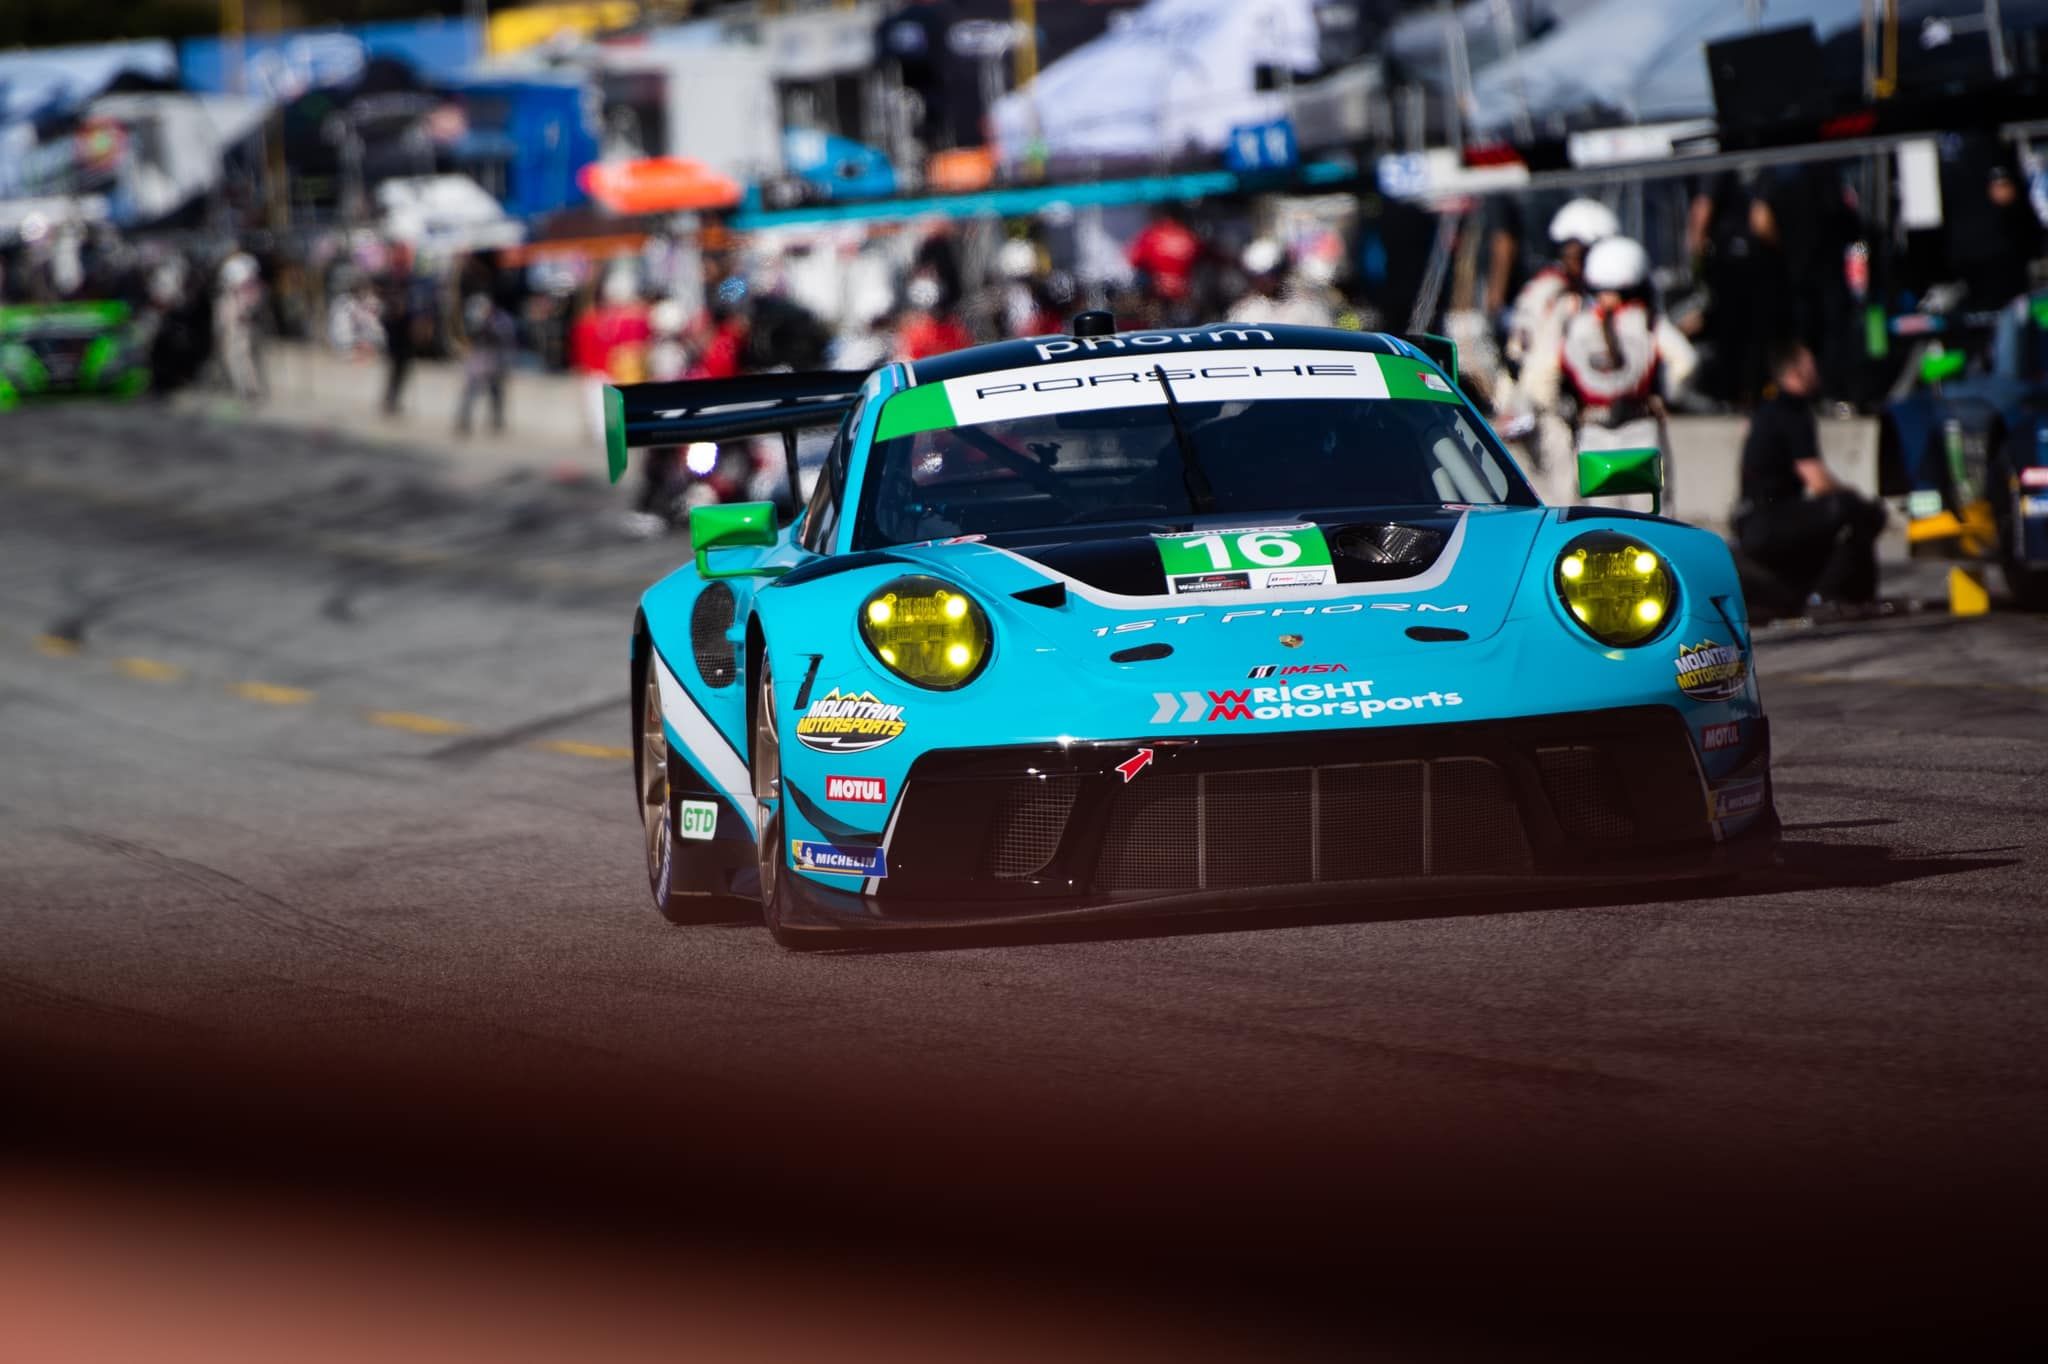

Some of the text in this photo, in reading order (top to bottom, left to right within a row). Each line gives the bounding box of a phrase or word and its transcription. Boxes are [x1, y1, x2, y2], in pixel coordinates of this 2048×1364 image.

[1035, 328, 1274, 360] phorm
[977, 363, 1358, 399] PORSCHE
[1183, 532, 1302, 570] 16
[1091, 603, 1470, 637] 1ST PHORM
[1280, 663, 1348, 676] IMSA
[807, 700, 905, 721] MOUNTAIN
[797, 717, 906, 736] MOTORSPORTS
[1704, 725, 1739, 749] MOTUL
[828, 779, 883, 800] MOTUL
[683, 807, 715, 833] GTD
[815, 852, 877, 868] MICHELIN
